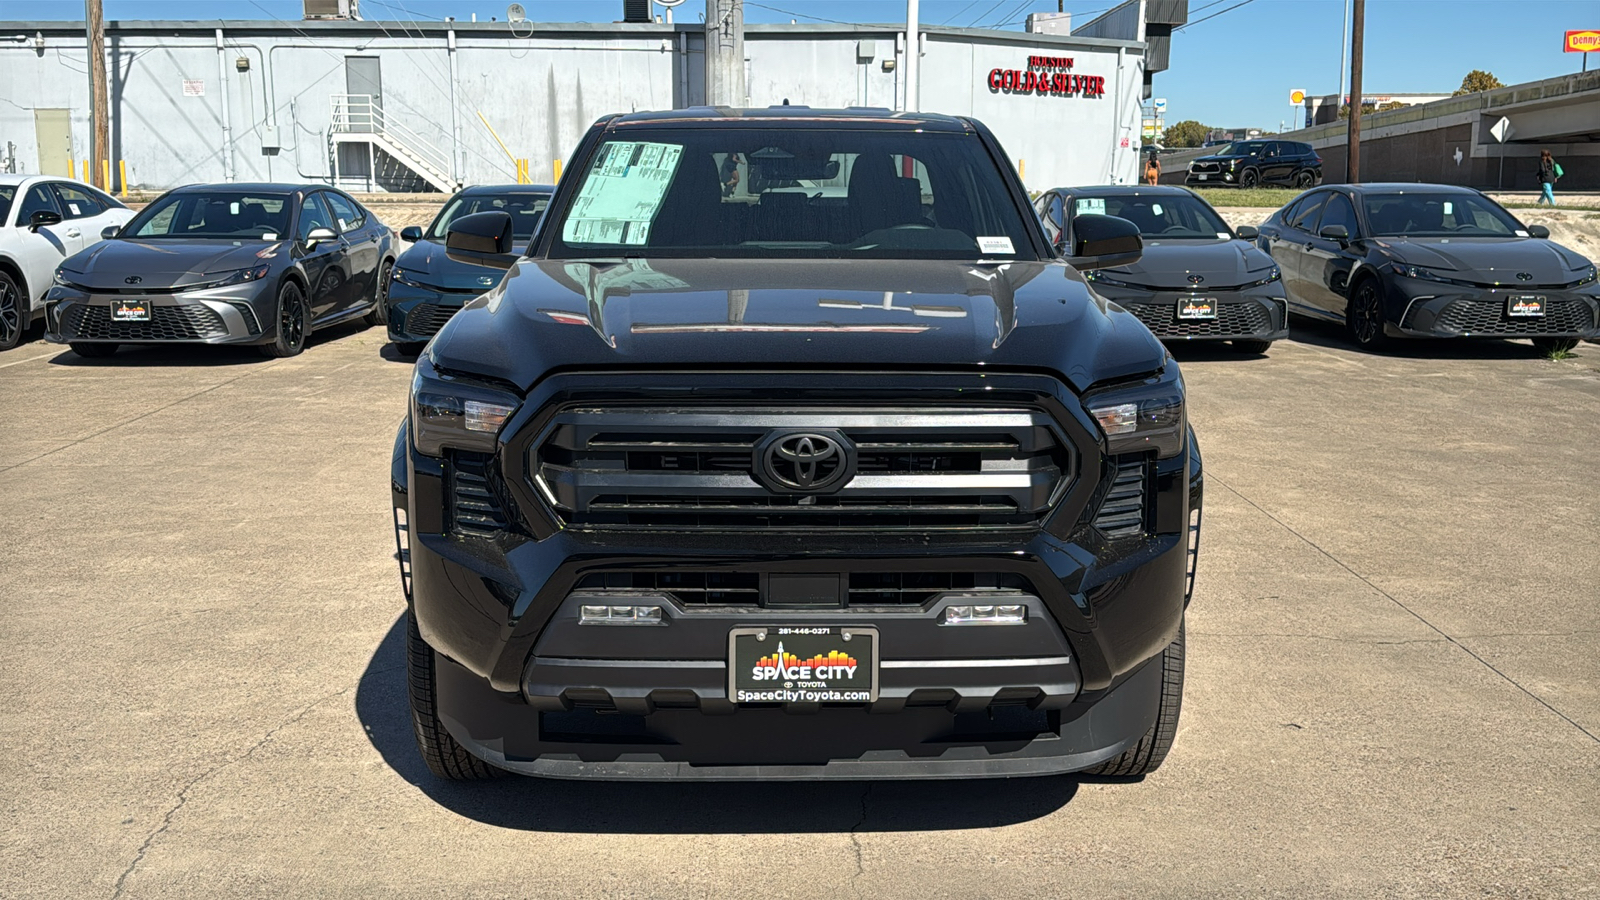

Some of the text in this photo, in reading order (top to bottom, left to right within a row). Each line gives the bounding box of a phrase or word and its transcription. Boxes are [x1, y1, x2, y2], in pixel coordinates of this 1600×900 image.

[1029, 56, 1074, 68] HOUSTON
[752, 665, 858, 681] SPACE CITY
[737, 690, 870, 702] SpaceCityToyota.com
